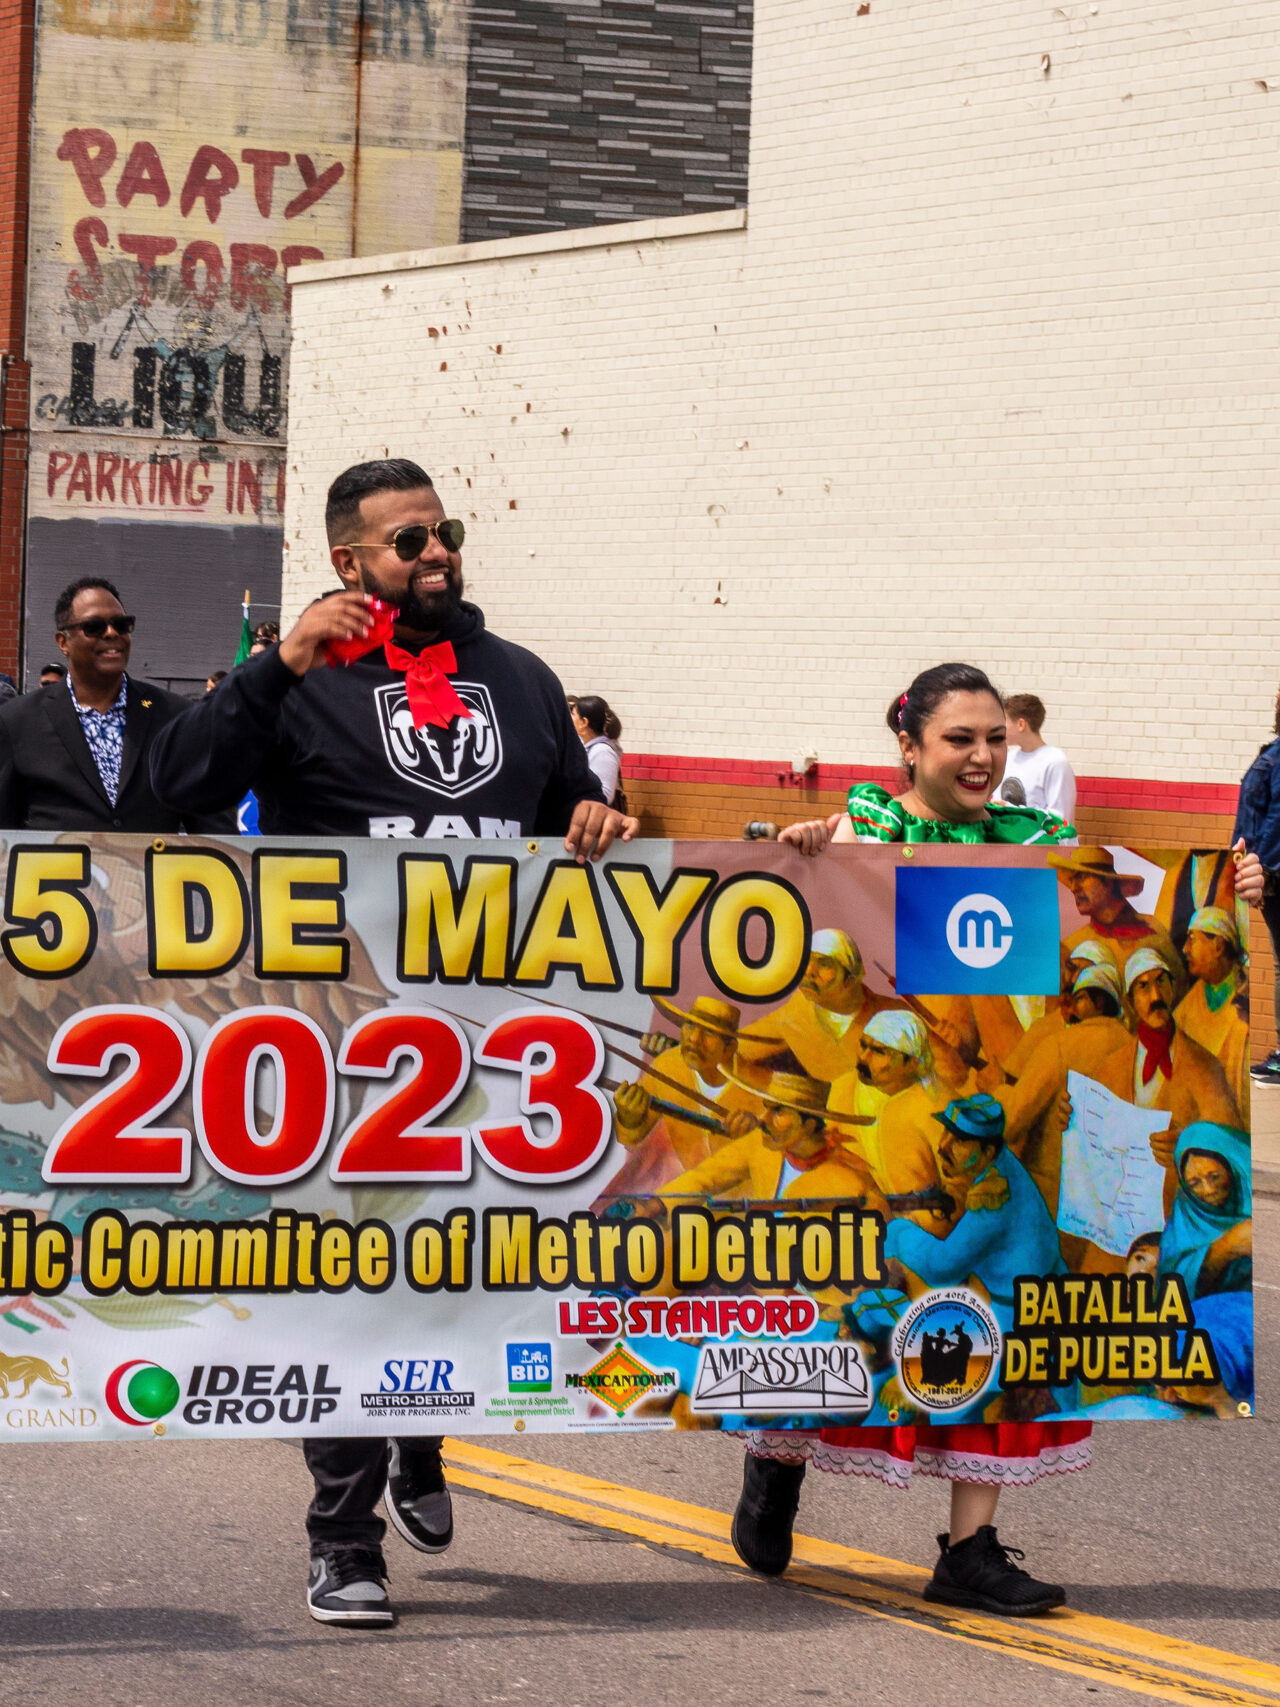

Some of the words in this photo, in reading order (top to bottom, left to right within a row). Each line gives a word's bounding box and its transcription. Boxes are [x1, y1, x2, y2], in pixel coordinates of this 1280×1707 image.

[57, 128, 346, 224] PARTY
[47, 451, 214, 506] PARKING
[226, 460, 262, 515] IN
[368, 815, 522, 839] RAM
[1, 845, 98, 979] 5
[146, 846, 350, 980] DE
[397, 853, 811, 1001] MAYO
[42, 1004, 613, 1186] 2023
[85, 1208, 393, 1292] Commitee
[407, 1205, 468, 1291] of
[483, 1208, 664, 1290] Metro
[673, 1206, 886, 1289] Detroit
[559, 1301, 619, 1335] LES
[627, 1300, 815, 1336] STANFORD
[1015, 1277, 1191, 1327] BATALLA
[895, 1303, 927, 1357] Celebrating
[926, 1293, 942, 1304] our
[945, 1291, 967, 1300] 40th
[968, 1297, 1000, 1355] Anniversary
[511, 1365, 549, 1381] BID
[696, 1346, 868, 1395] AMBASSADOR
[1003, 1335, 1051, 1383] DE
[1056, 1333, 1218, 1382] PUEBLA
[187, 1364, 342, 1397] IDEAL
[380, 1360, 454, 1392] SER
[565, 1372, 676, 1388] MEXICANTOWN
[183, 1399, 338, 1425] GROUP
[362, 1393, 473, 1407] METRO-DETROIT
[367, 1408, 387, 1417] JOBS
[389, 1408, 406, 1416] FOR
[408, 1408, 453, 1416] PROGRESS,
[454, 1407, 471, 1416] INC.
[485, 1408, 512, 1416] Business
[514, 1408, 552, 1417] Improvement
[553, 1407, 575, 1415] District
[491, 1398, 506, 1406] West
[507, 1398, 527, 1406] Verner
[6, 1408, 97, 1428] GRAND
